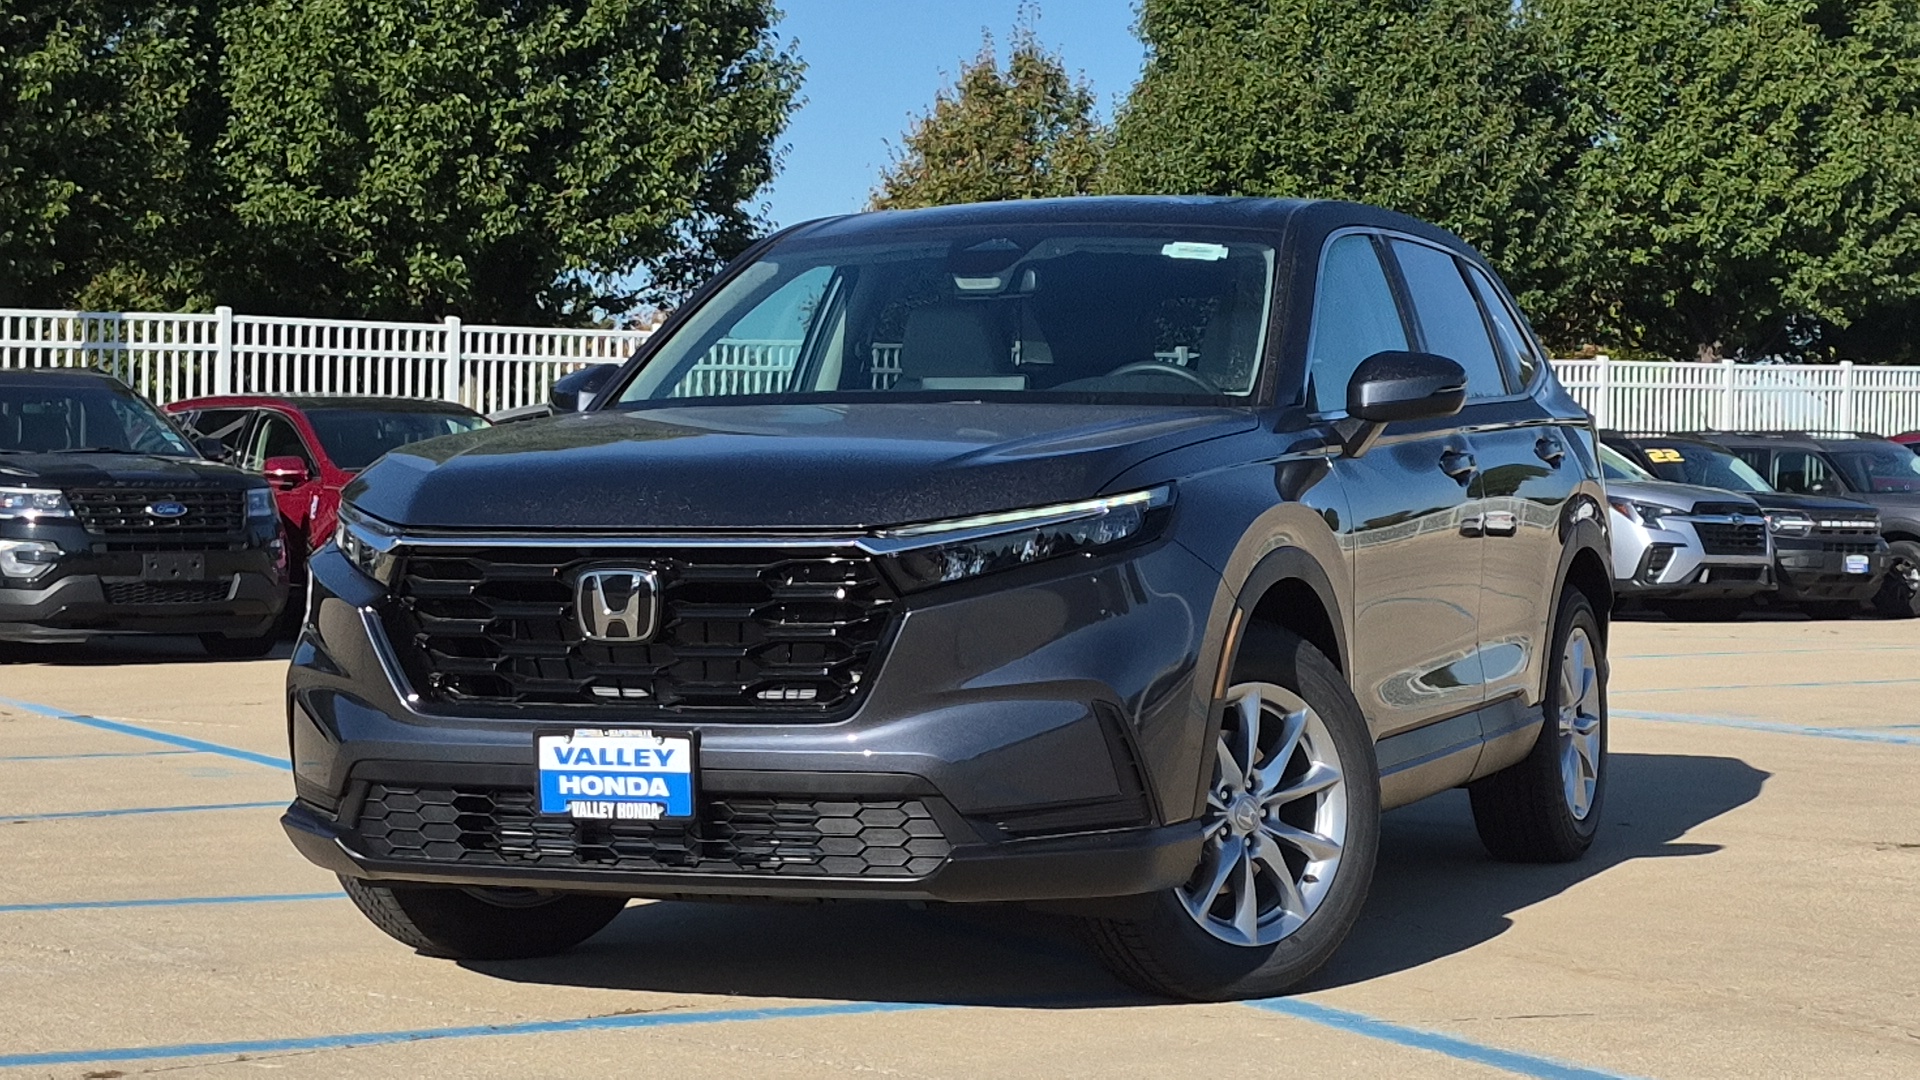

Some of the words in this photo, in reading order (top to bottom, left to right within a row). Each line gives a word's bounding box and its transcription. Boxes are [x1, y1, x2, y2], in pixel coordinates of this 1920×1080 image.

[1644, 448, 1685, 463] 22
[553, 746, 676, 767] VALLEY
[559, 775, 670, 797] HONDA
[571, 801, 615, 819] VALLEY
[617, 802, 660, 820] HONDA
